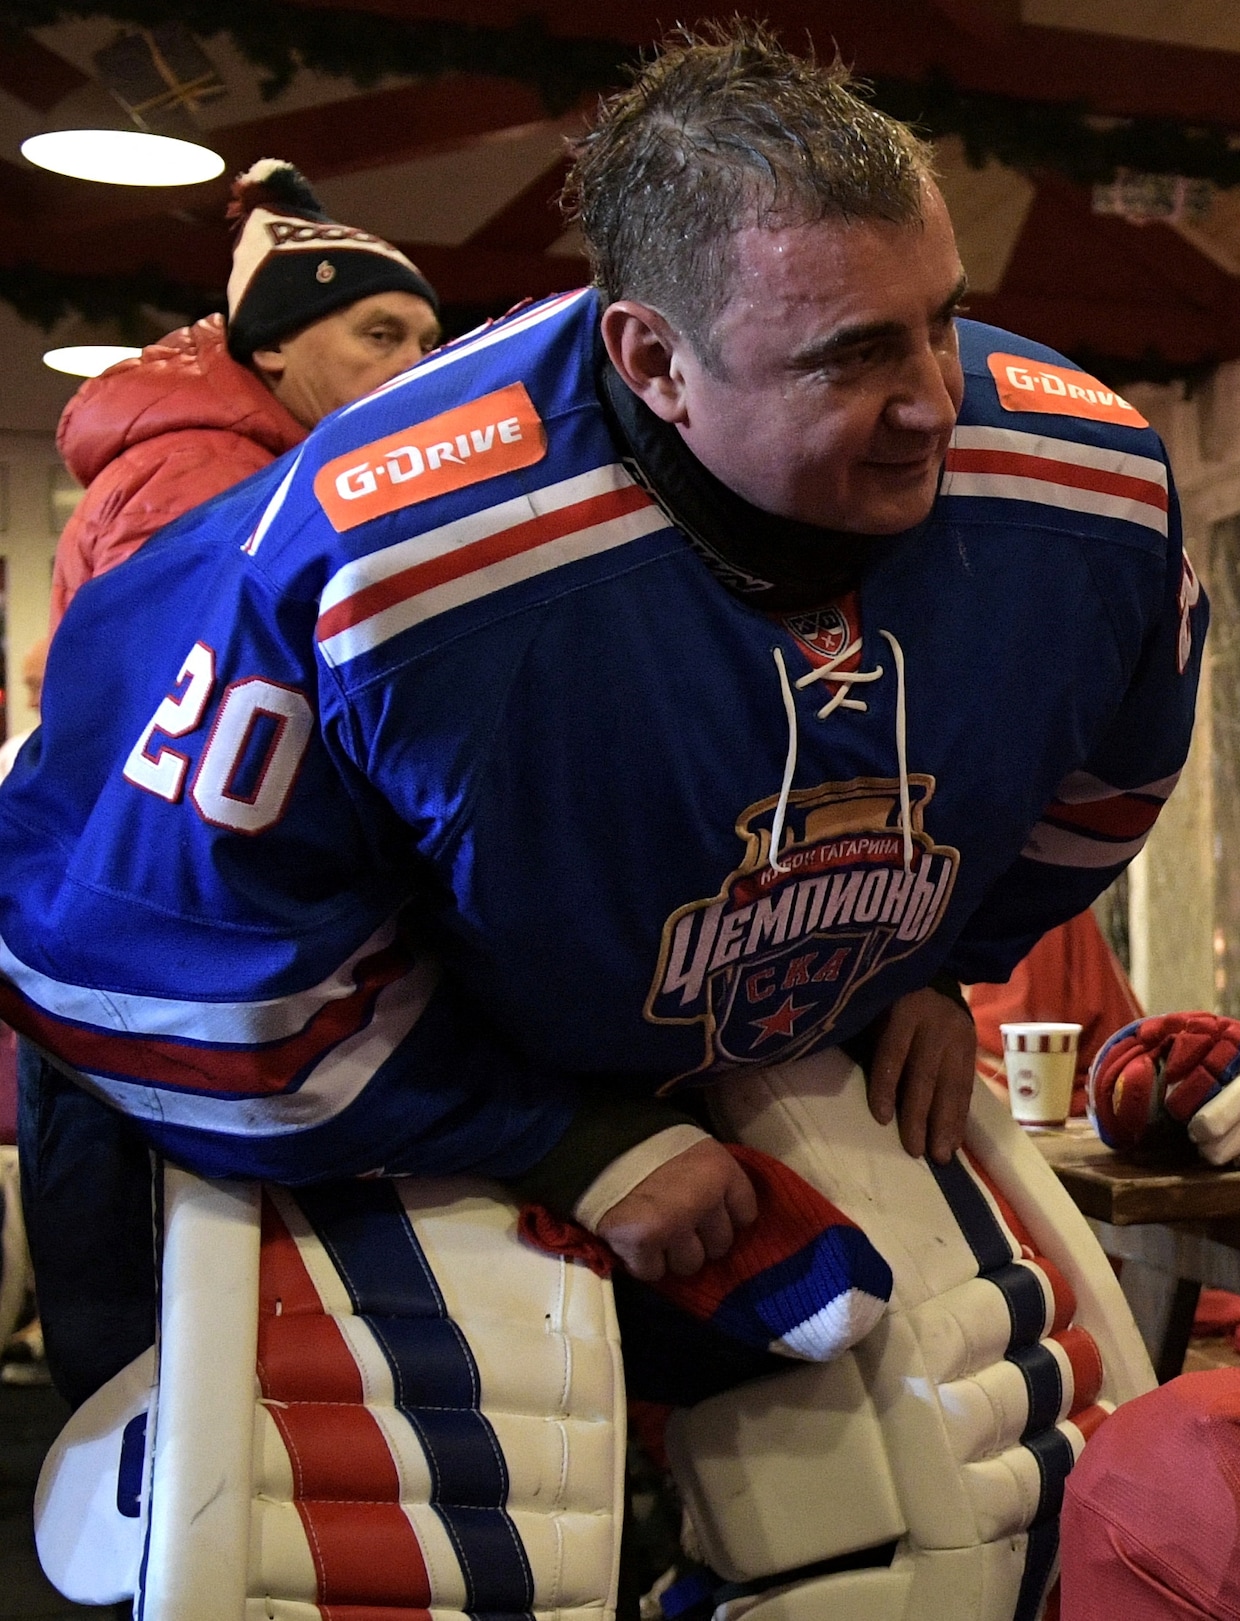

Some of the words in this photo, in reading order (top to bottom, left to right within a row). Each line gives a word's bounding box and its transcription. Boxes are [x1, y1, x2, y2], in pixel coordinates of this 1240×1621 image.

[122, 638, 315, 837] 20
[819, 838, 899, 862] ГАГАРИНА
[661, 853, 951, 1007] ЧЕМПИОНЫ
[746, 947, 852, 1004] СКА
